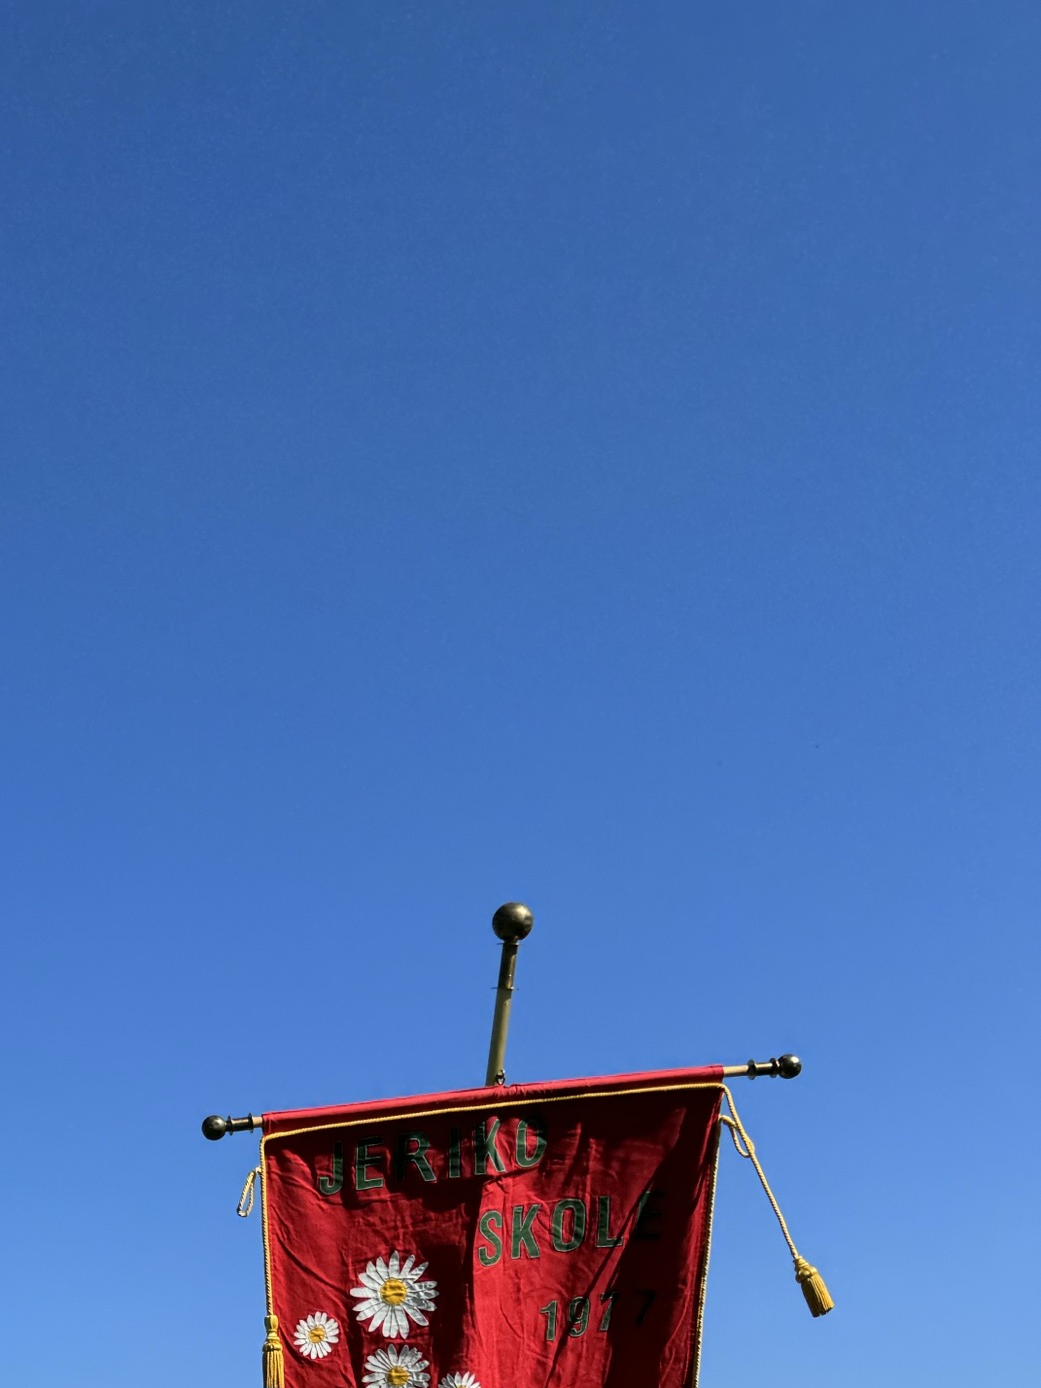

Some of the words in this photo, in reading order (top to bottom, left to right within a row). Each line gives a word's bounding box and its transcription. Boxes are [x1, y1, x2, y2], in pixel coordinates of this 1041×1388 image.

[319, 1116, 547, 1195] JERIKO
[477, 1190, 665, 1267] SKOLE
[540, 1289, 655, 1341] 1977
